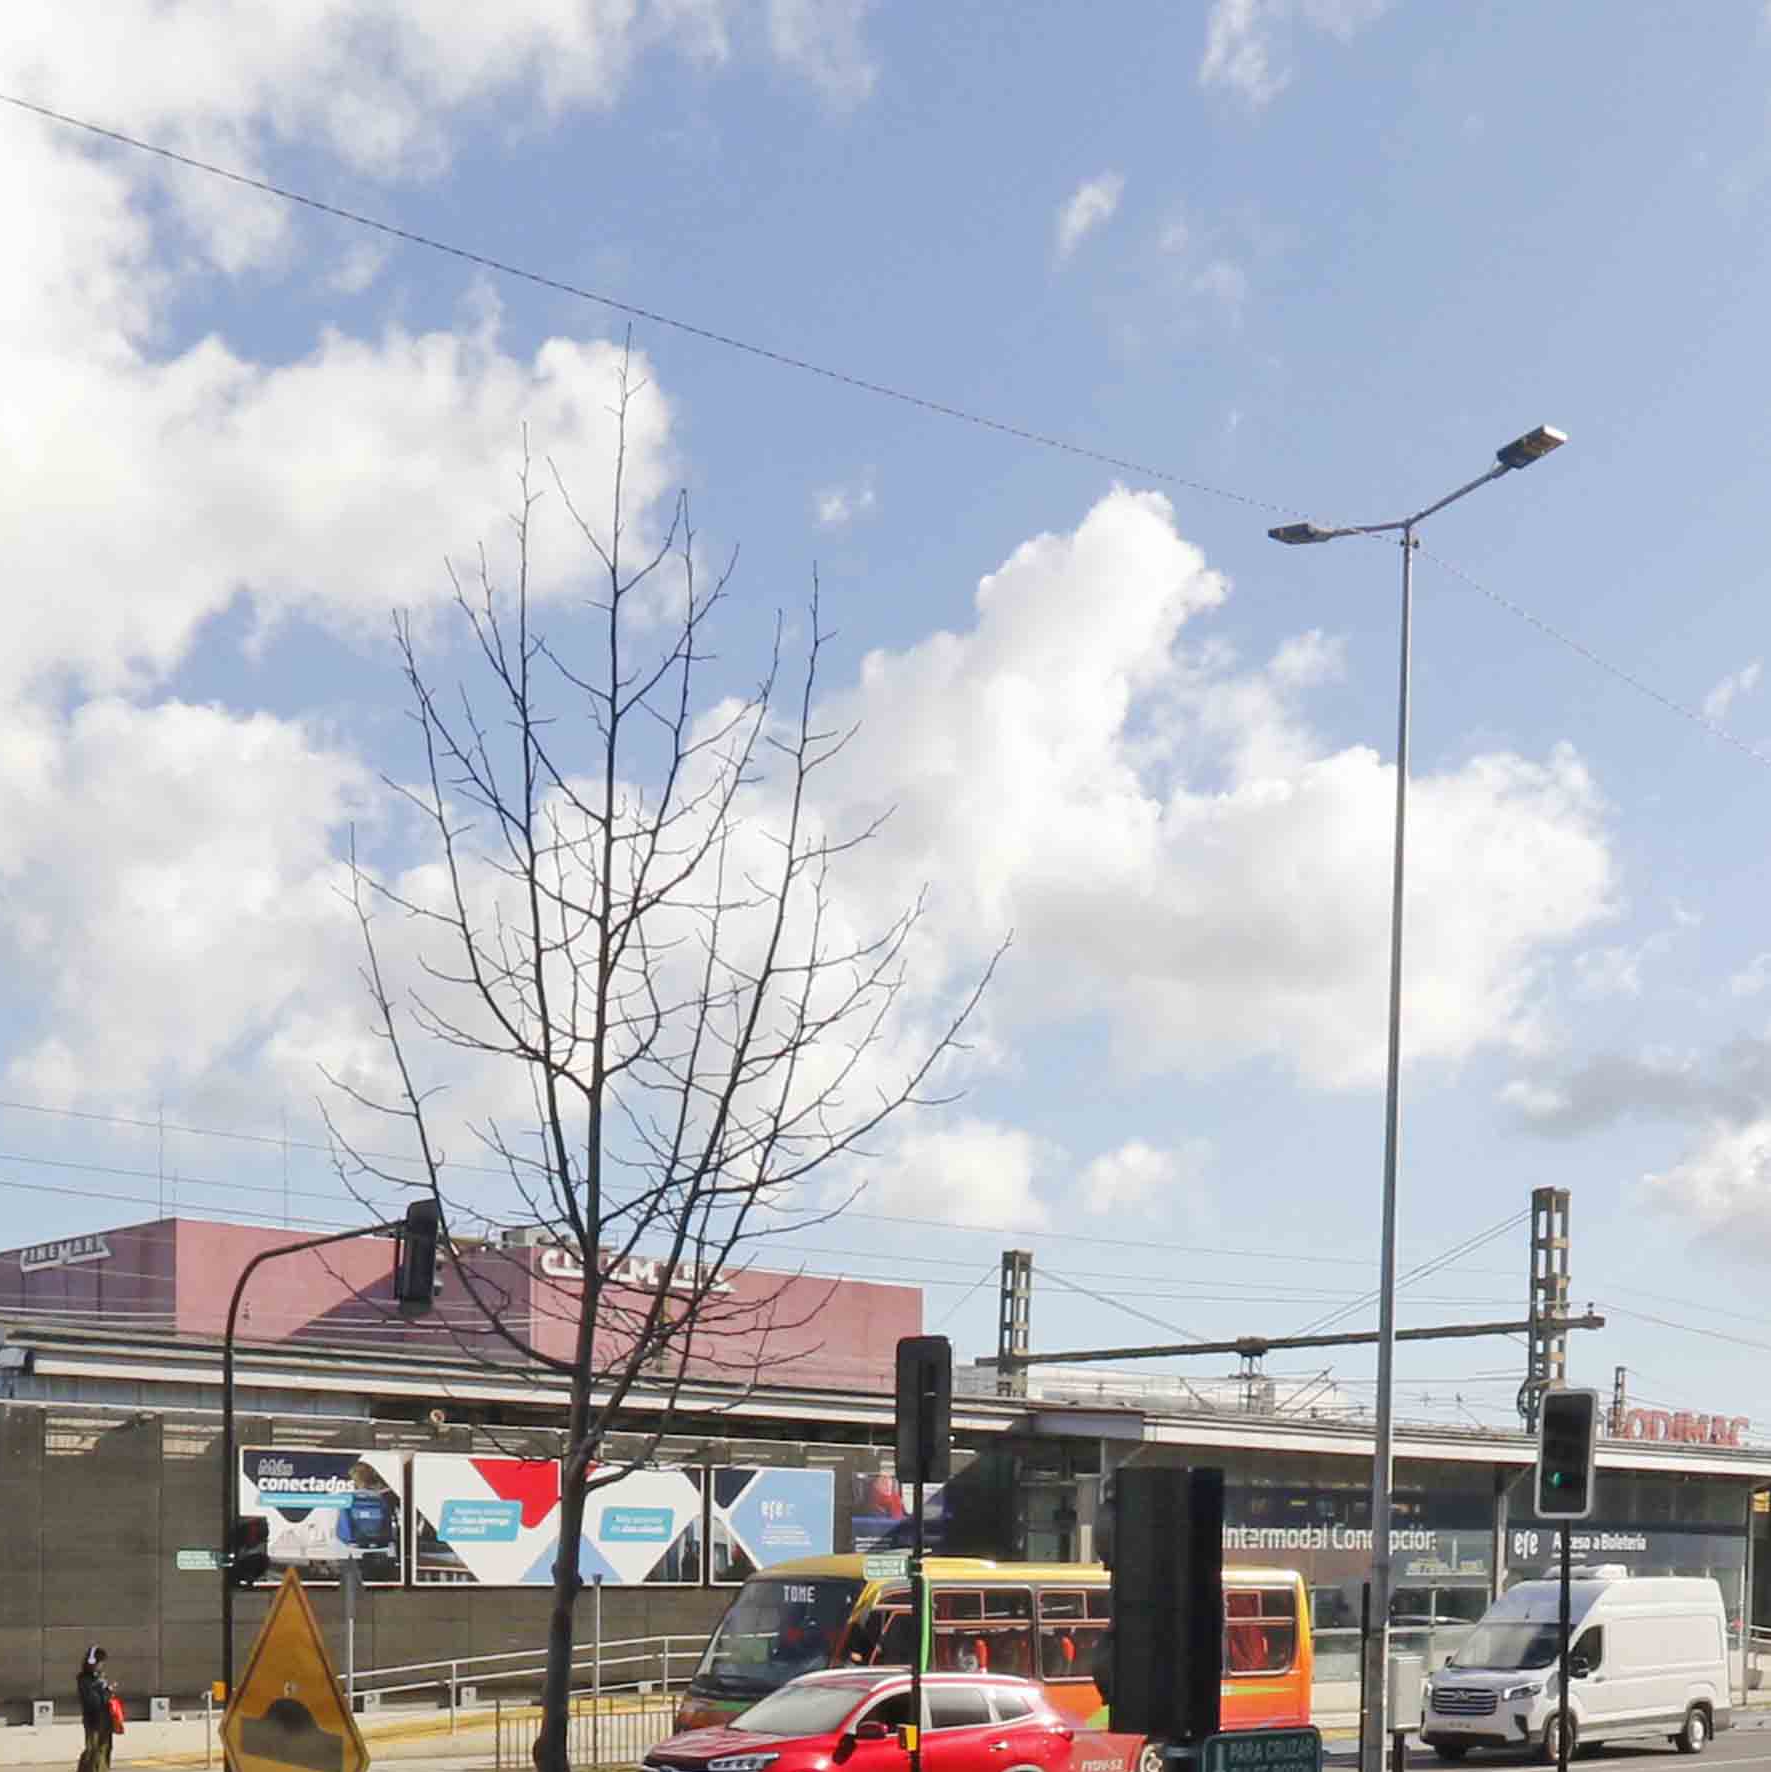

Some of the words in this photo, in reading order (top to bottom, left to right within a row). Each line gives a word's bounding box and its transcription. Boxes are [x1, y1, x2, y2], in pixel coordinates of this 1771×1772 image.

[20, 1233, 112, 1273] CINEMARK
[258, 1476, 357, 1492] conectados
[1222, 1521, 1327, 1550] Intermodal
[1514, 1530, 1539, 1559] efe
[1229, 1742, 1262, 1762] PARA
[1265, 1736, 1315, 1761] CRUZAR
